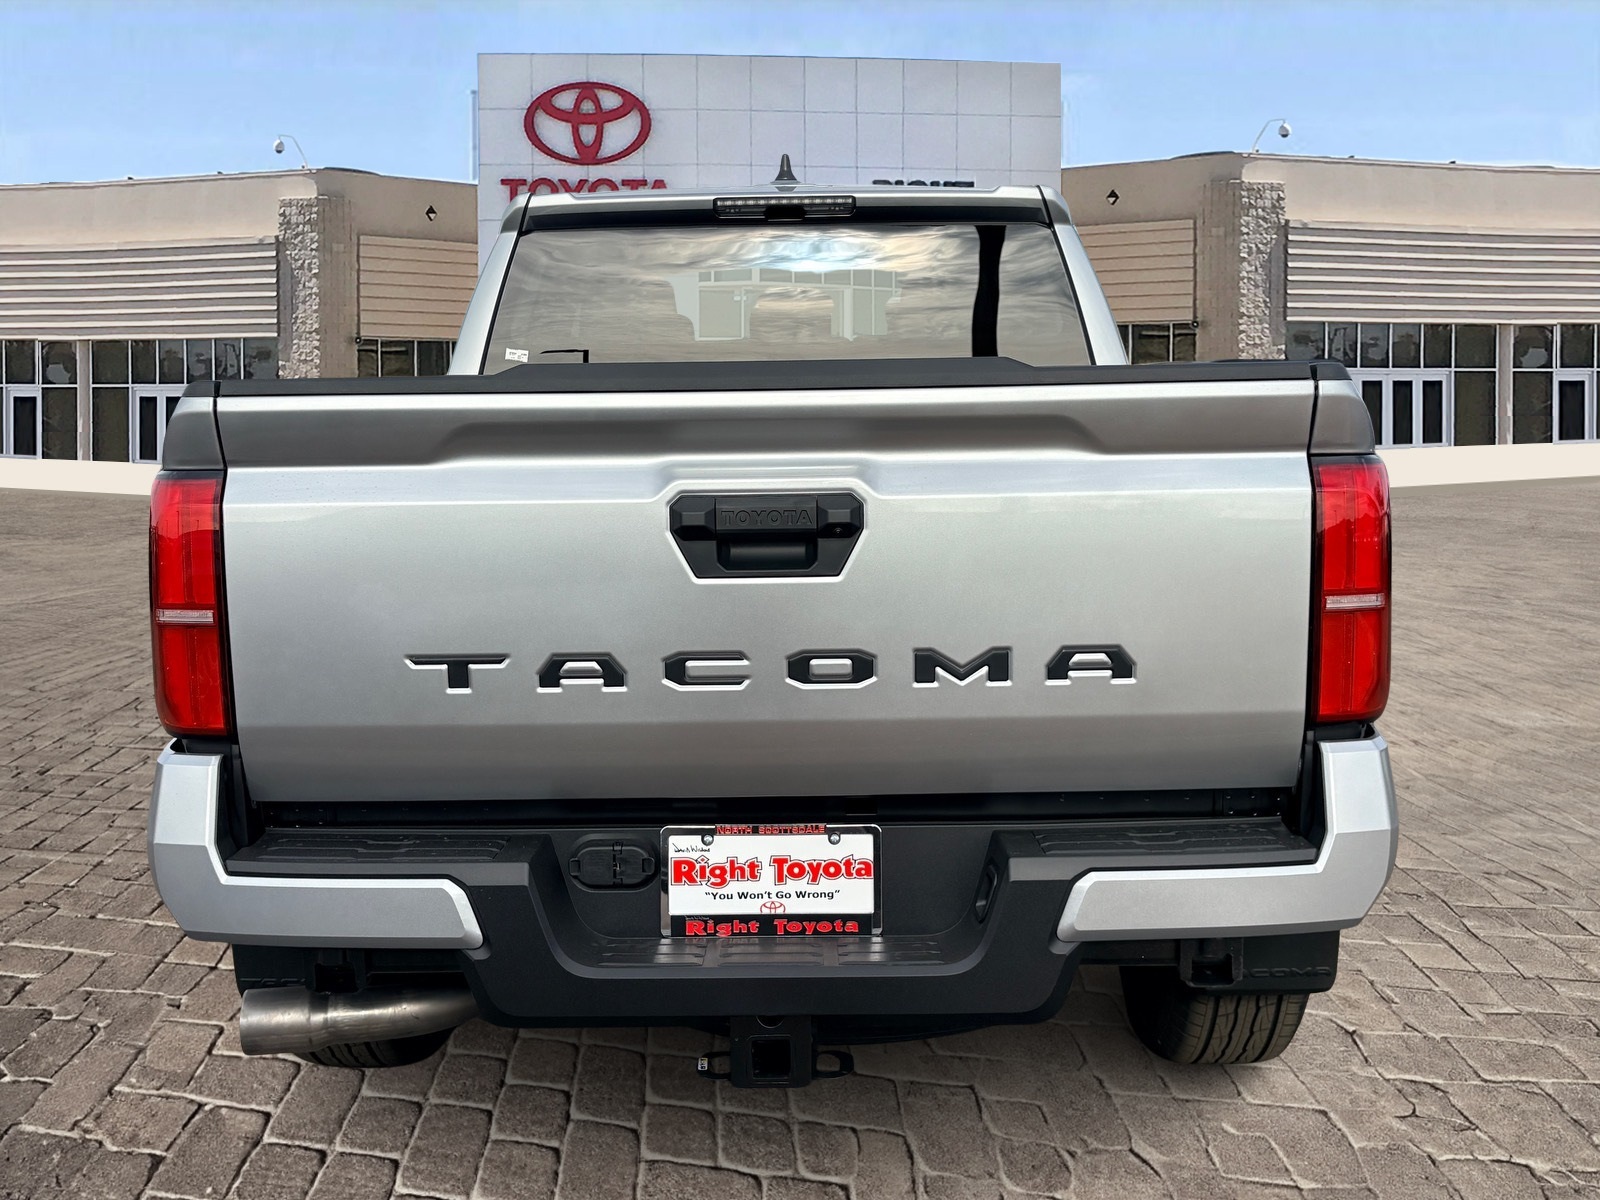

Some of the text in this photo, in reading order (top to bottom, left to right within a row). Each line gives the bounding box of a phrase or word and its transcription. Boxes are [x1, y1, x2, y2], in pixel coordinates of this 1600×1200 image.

[721, 509, 813, 526] TOYOTA
[403, 644, 1138, 694] TACOMA
[716, 824, 826, 834] NORTH SCOTTSDALE
[670, 854, 874, 889] Right Toyota
[775, 889, 792, 900] Go
[685, 918, 859, 937] Right Toyota
